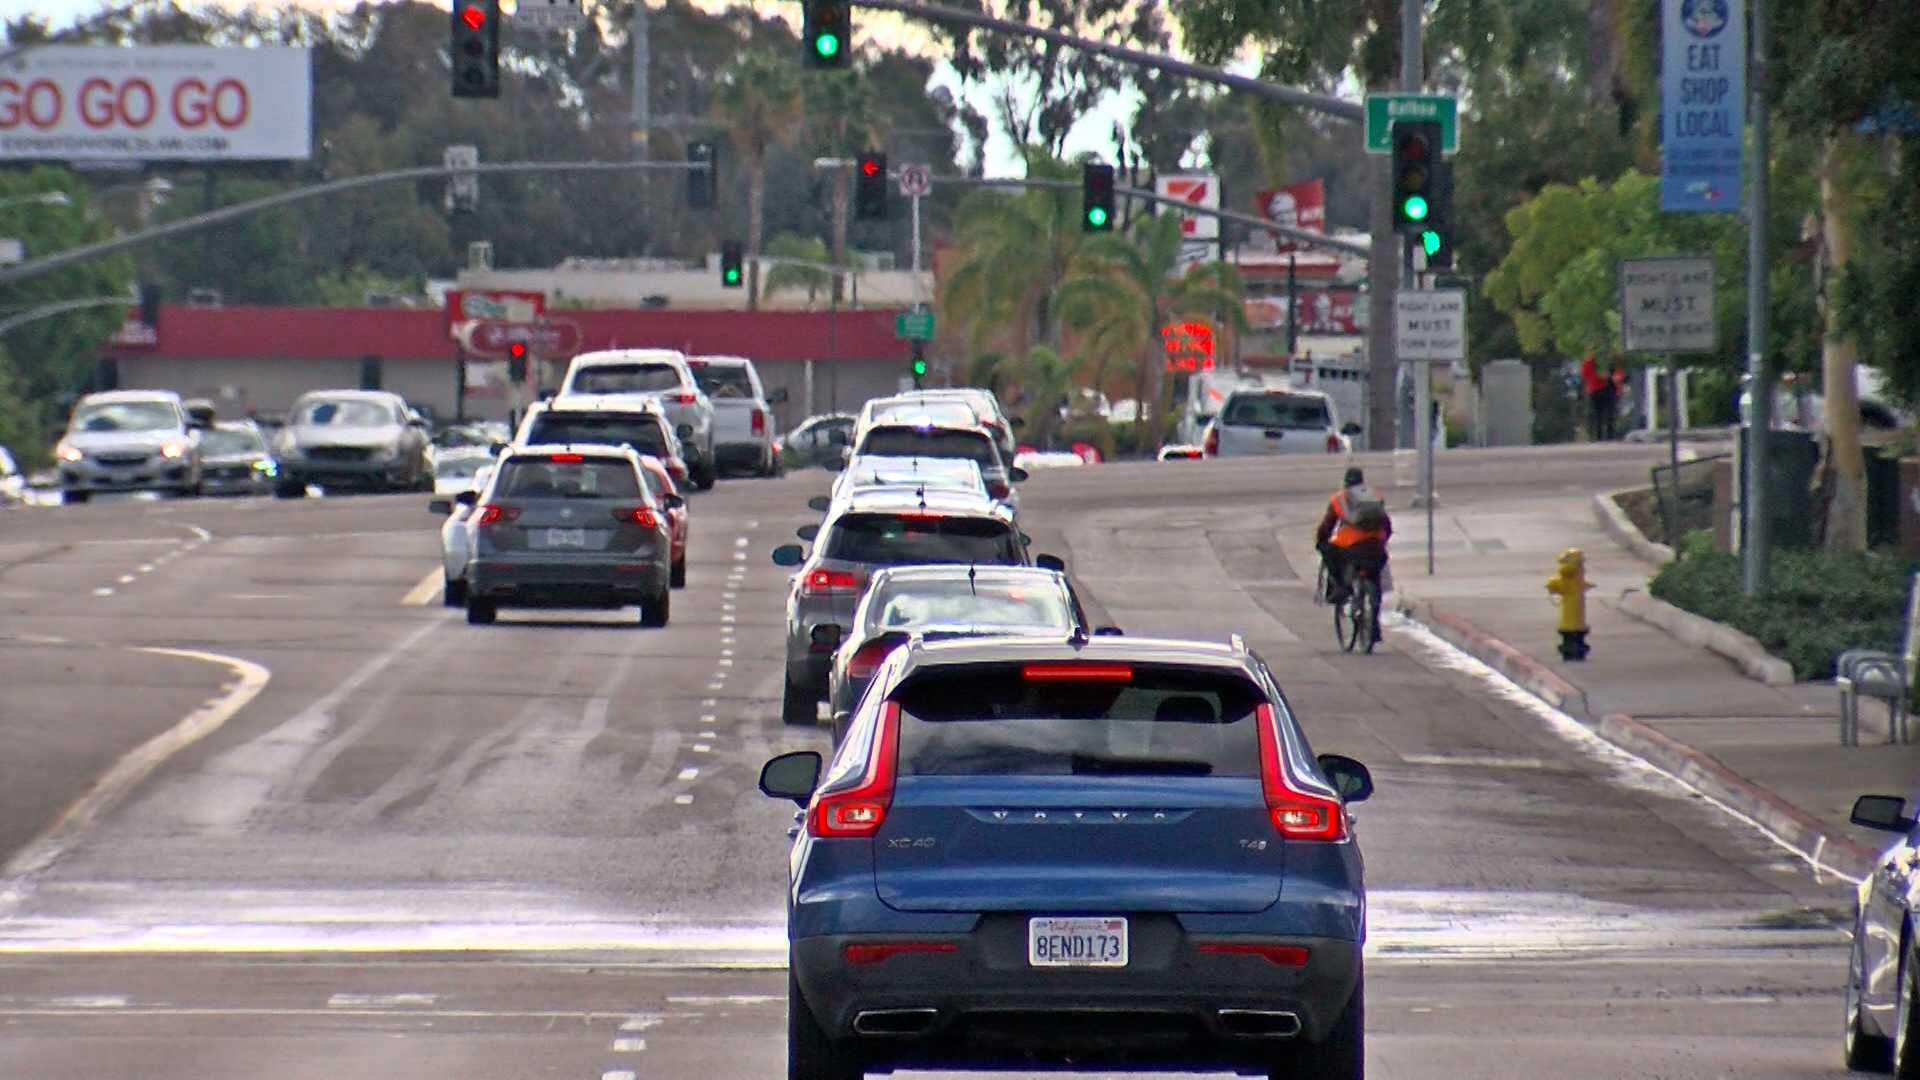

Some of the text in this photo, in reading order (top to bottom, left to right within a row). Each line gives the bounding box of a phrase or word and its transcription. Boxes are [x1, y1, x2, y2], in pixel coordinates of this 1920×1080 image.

[1687, 45, 1721, 71] EAT
[77, 77, 156, 130] GO
[170, 77, 249, 130] GO
[1681, 77, 1729, 104] SHOP
[1676, 111, 1733, 137] LOCAL
[1642, 296, 1695, 312] MUST
[1408, 320, 1451, 332] MUST
[1036, 935, 1120, 958] 8END173
